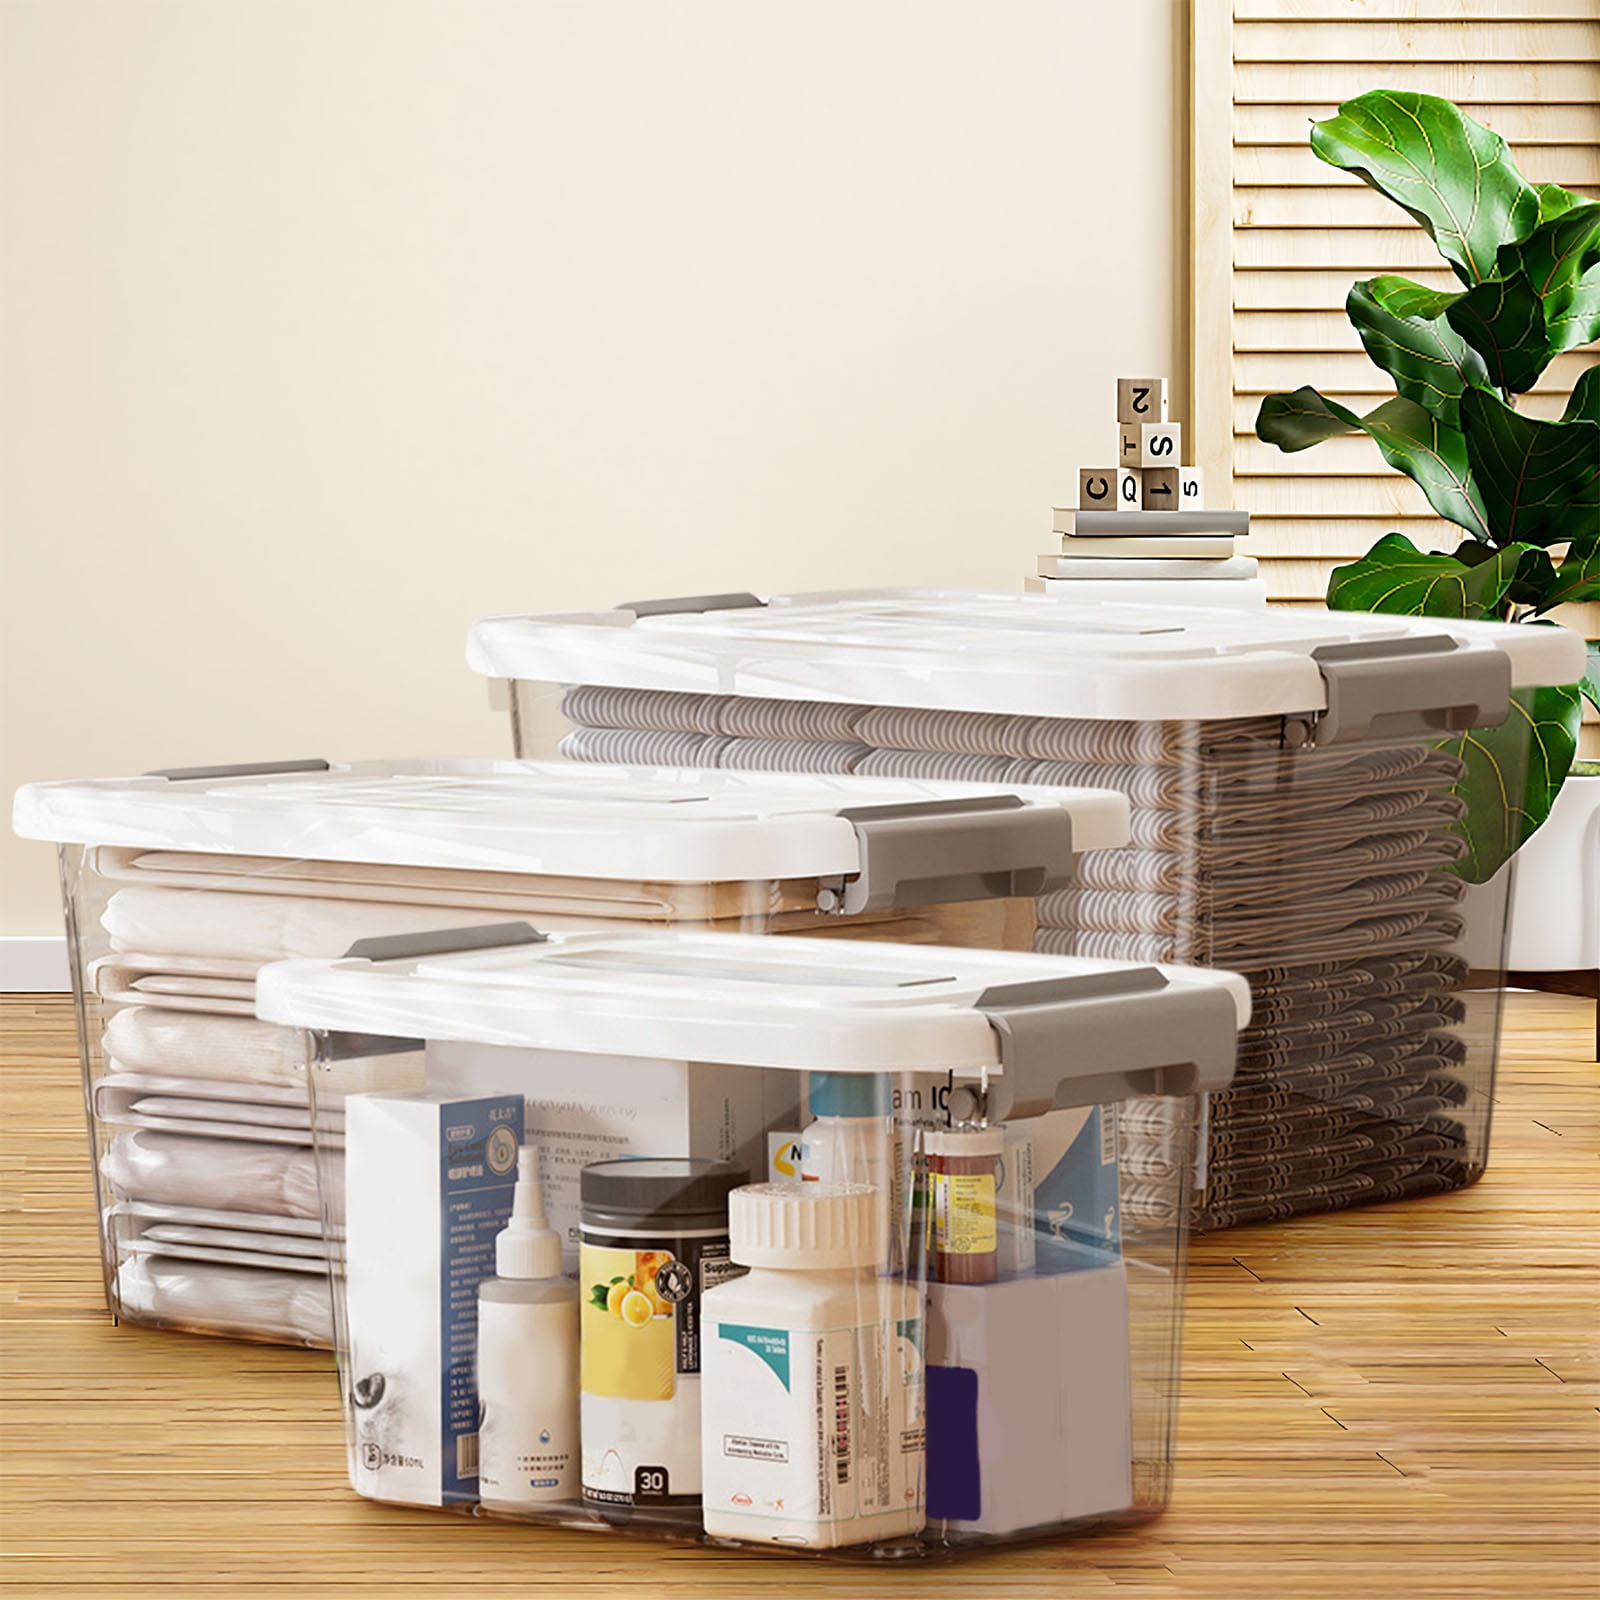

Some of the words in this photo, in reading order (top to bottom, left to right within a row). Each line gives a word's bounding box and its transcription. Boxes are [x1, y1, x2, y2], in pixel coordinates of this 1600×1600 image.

[1132, 387, 1149, 413] 2
[1123, 435, 1137, 456] T
[1149, 435, 1173, 456] S
[1086, 477, 1109, 500] C
[1122, 475, 1137, 502] Q
[1150, 482, 1172, 494] 1
[1183, 480, 1198, 497] 5
[641, 1473, 664, 1490] 30
